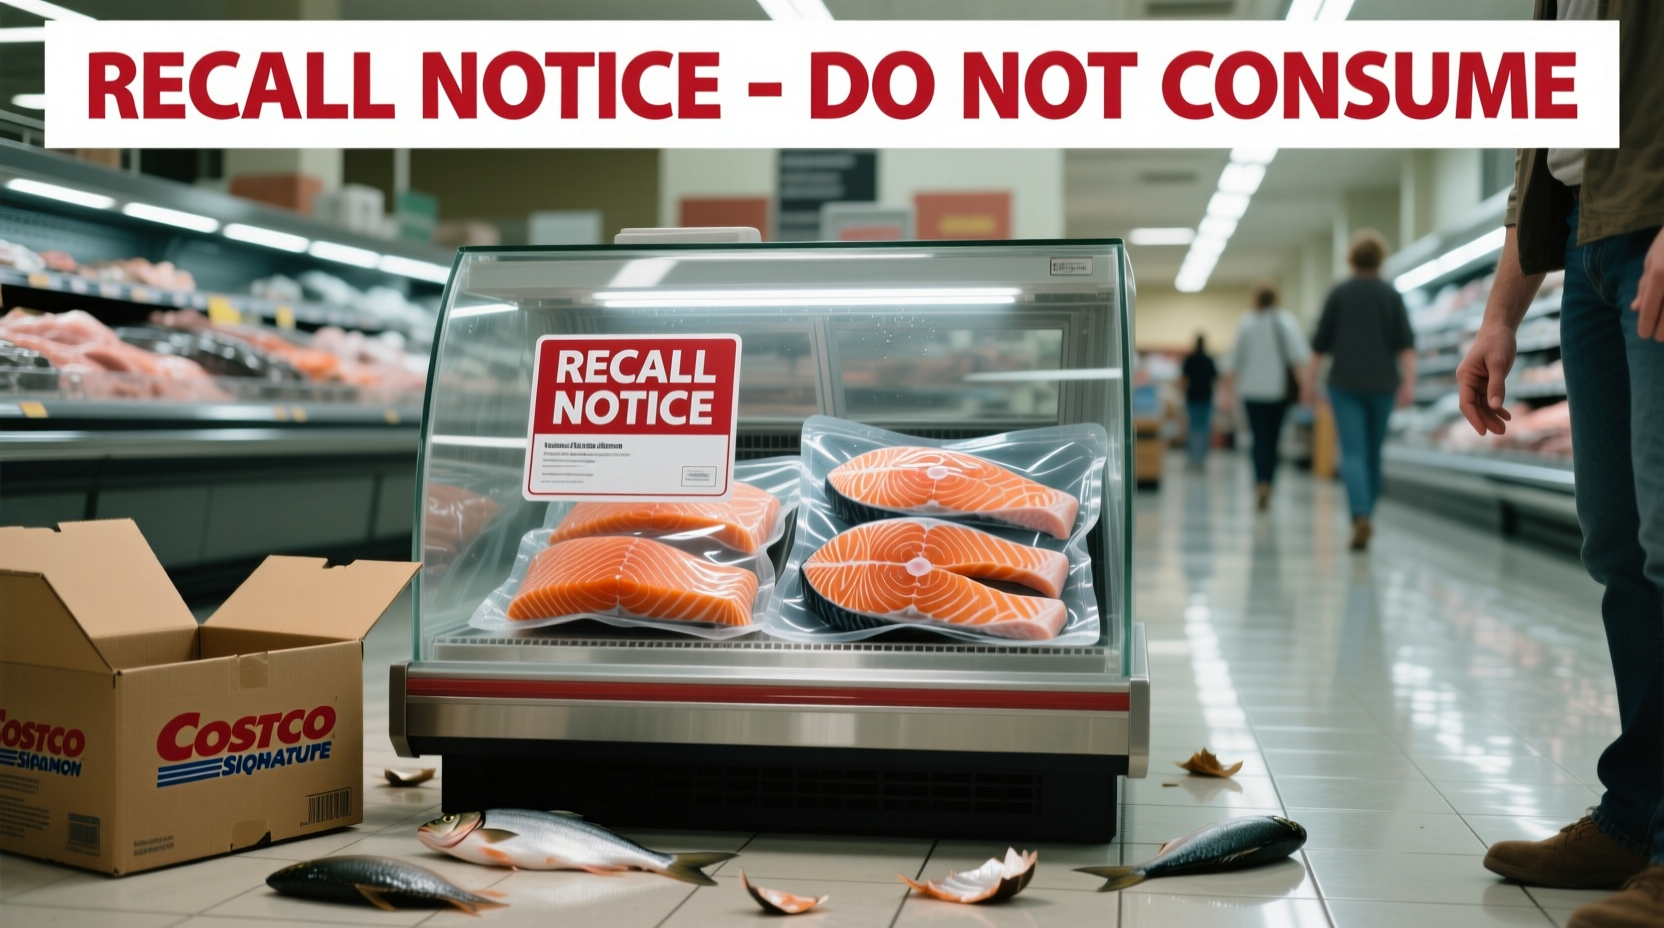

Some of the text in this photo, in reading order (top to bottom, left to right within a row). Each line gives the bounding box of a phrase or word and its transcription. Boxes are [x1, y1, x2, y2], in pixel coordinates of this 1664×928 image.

[556, 349, 717, 384] RECALL
[552, 389, 715, 426] NOTICE
[156, 705, 337, 762] COSTCO
